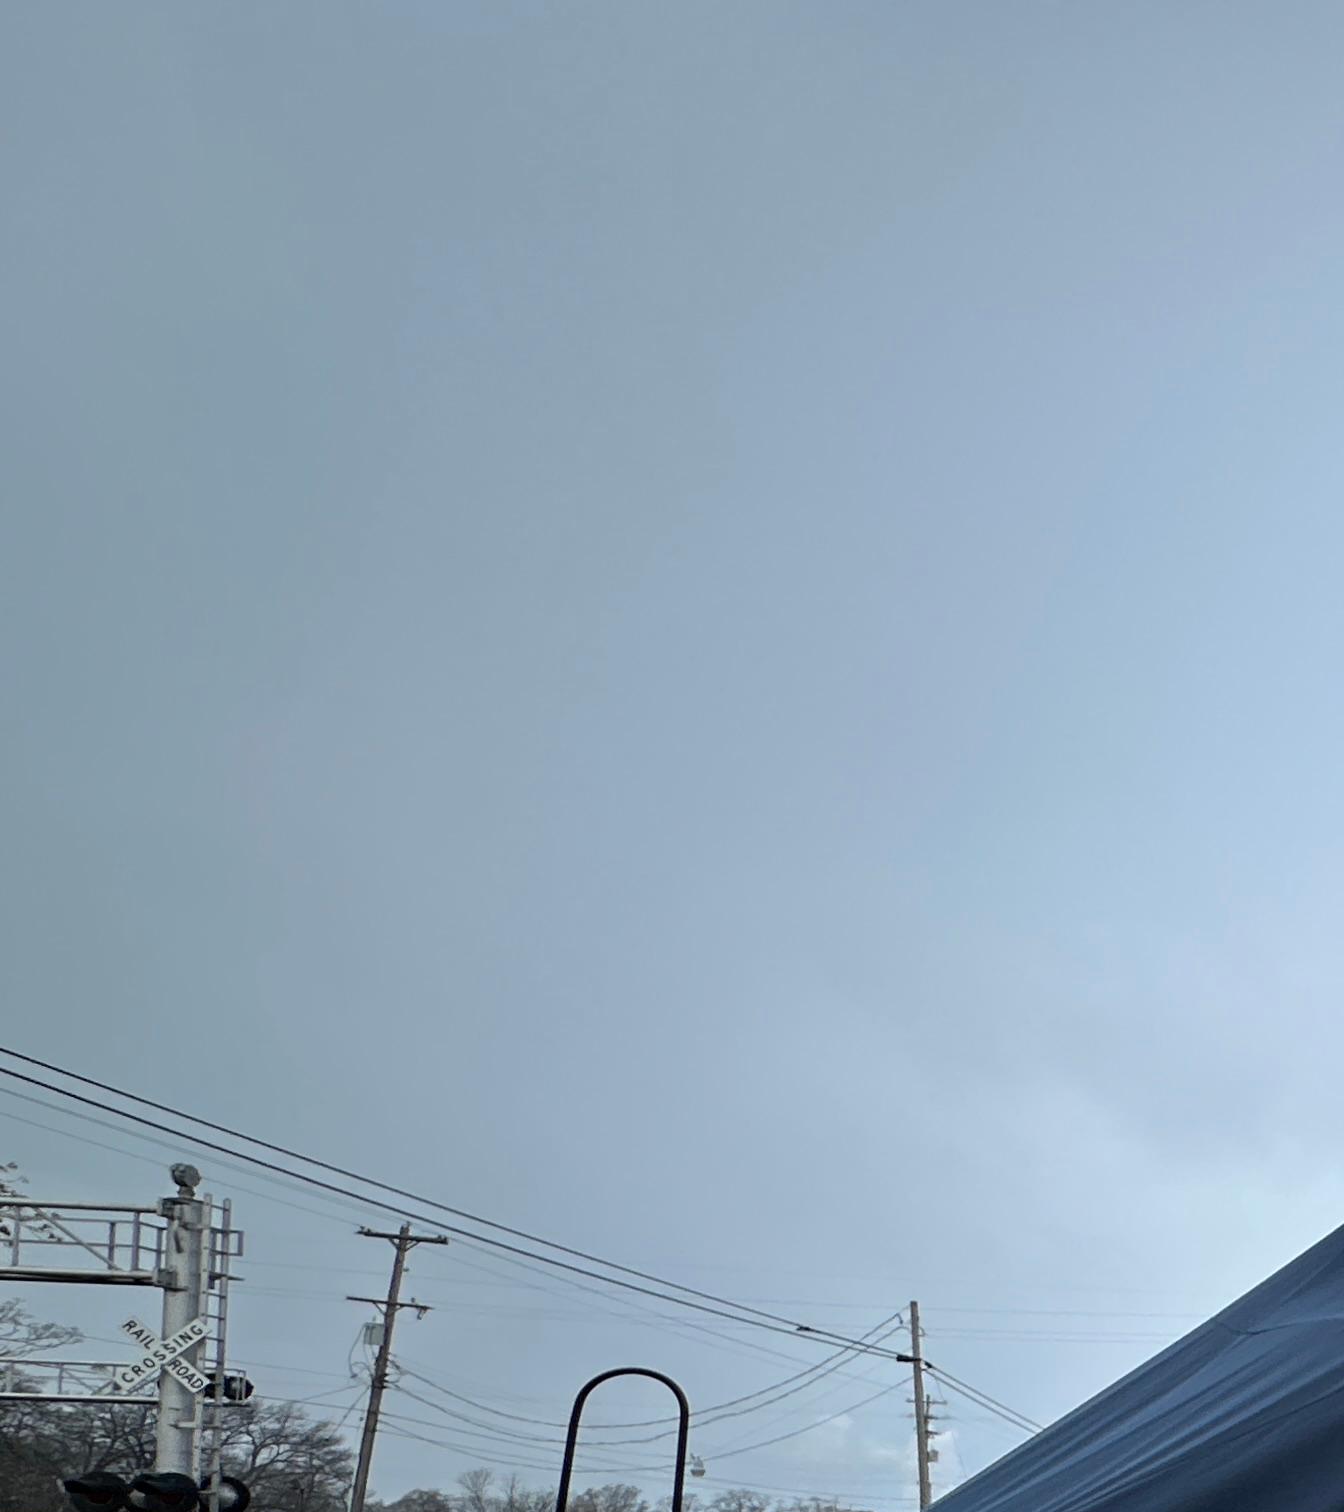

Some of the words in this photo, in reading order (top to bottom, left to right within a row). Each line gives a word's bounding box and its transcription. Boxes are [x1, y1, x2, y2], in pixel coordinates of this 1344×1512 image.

[121, 1324, 204, 1383] CROSSING
[121, 1320, 156, 1350] RAIL
[167, 1359, 204, 1389] ROAD
